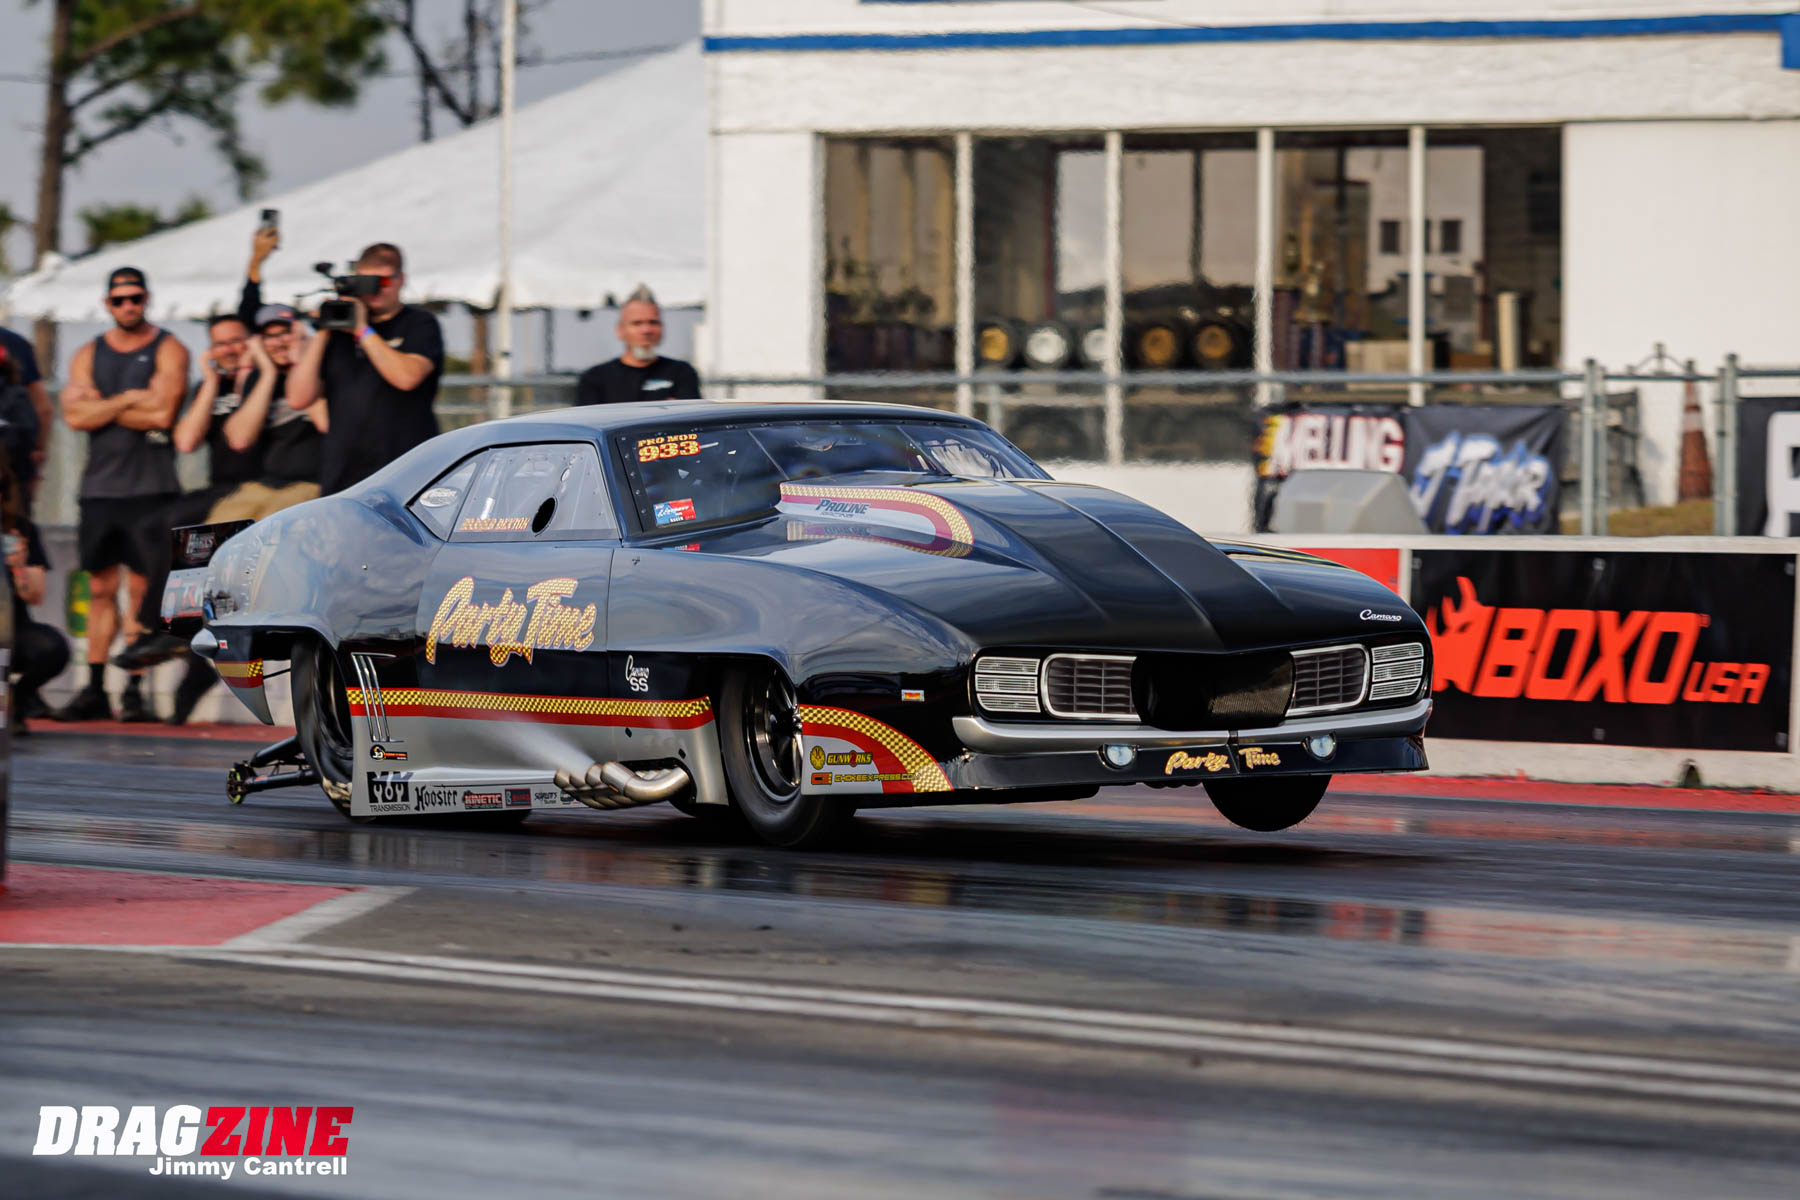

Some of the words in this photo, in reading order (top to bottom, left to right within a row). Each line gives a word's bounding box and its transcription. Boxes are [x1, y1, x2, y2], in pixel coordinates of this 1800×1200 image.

[637, 436, 665, 447] PRO
[667, 433, 698, 442] MOD
[638, 440, 701, 462] 933
[1269, 414, 1405, 478] MELLING
[815, 499, 870, 514] PROLINE
[425, 576, 528, 667] Party
[522, 577, 597, 665] Time
[1360, 609, 1402, 622] Camaro
[1472, 607, 1704, 705] BOXO
[1682, 660, 1771, 704] USA
[625, 654, 650, 681] Camaro
[630, 677, 649, 692] SS
[1164, 750, 1230, 775] Party
[1238, 747, 1281, 769] Time
[369, 803, 411, 812] TRANSMISSION
[414, 784, 458, 811] Hoosier
[465, 793, 502, 805] KINETIC
